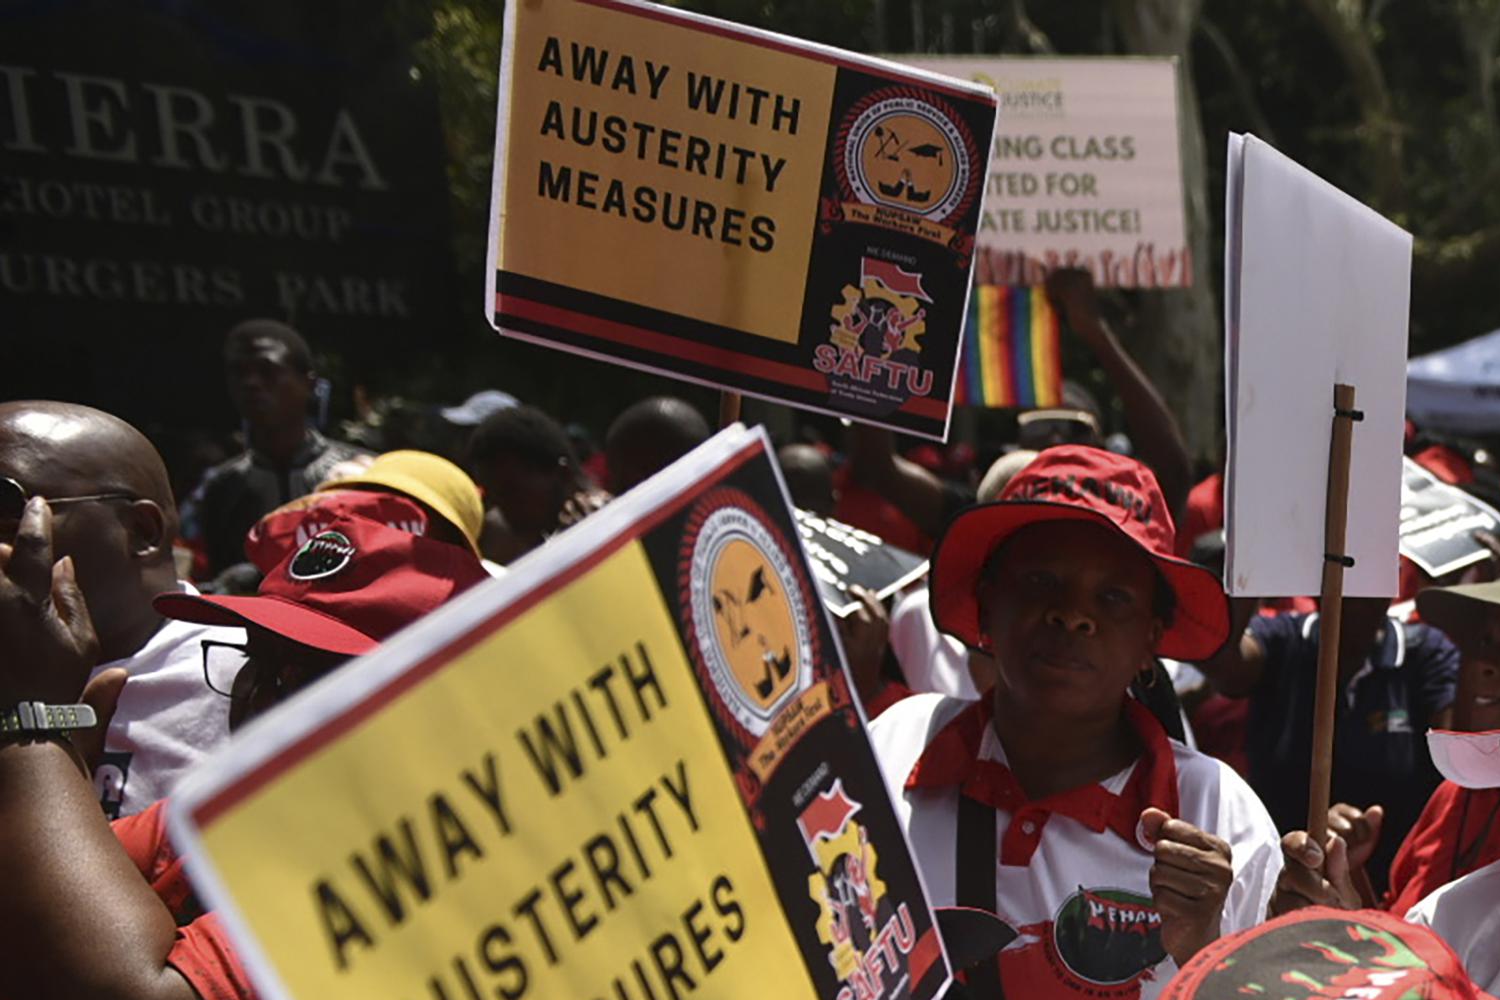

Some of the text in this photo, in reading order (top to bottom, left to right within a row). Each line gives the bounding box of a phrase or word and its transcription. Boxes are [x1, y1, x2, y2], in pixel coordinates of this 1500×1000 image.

[538, 36, 800, 136] AWAY WITH
[0, 64, 390, 191] IERRA
[540, 100, 787, 193] AUSTERITY
[1050, 136, 1136, 160] CLASS
[537, 160, 777, 253] MEASURES
[1045, 173, 1097, 196] FOR
[191, 192, 352, 243] GROUP
[1034, 209, 1141, 233] JUSTICE!
[0, 253, 411, 318] URGERS PARK
[813, 344, 934, 396] SAFTU
[311, 641, 667, 972] AWAY WITH
